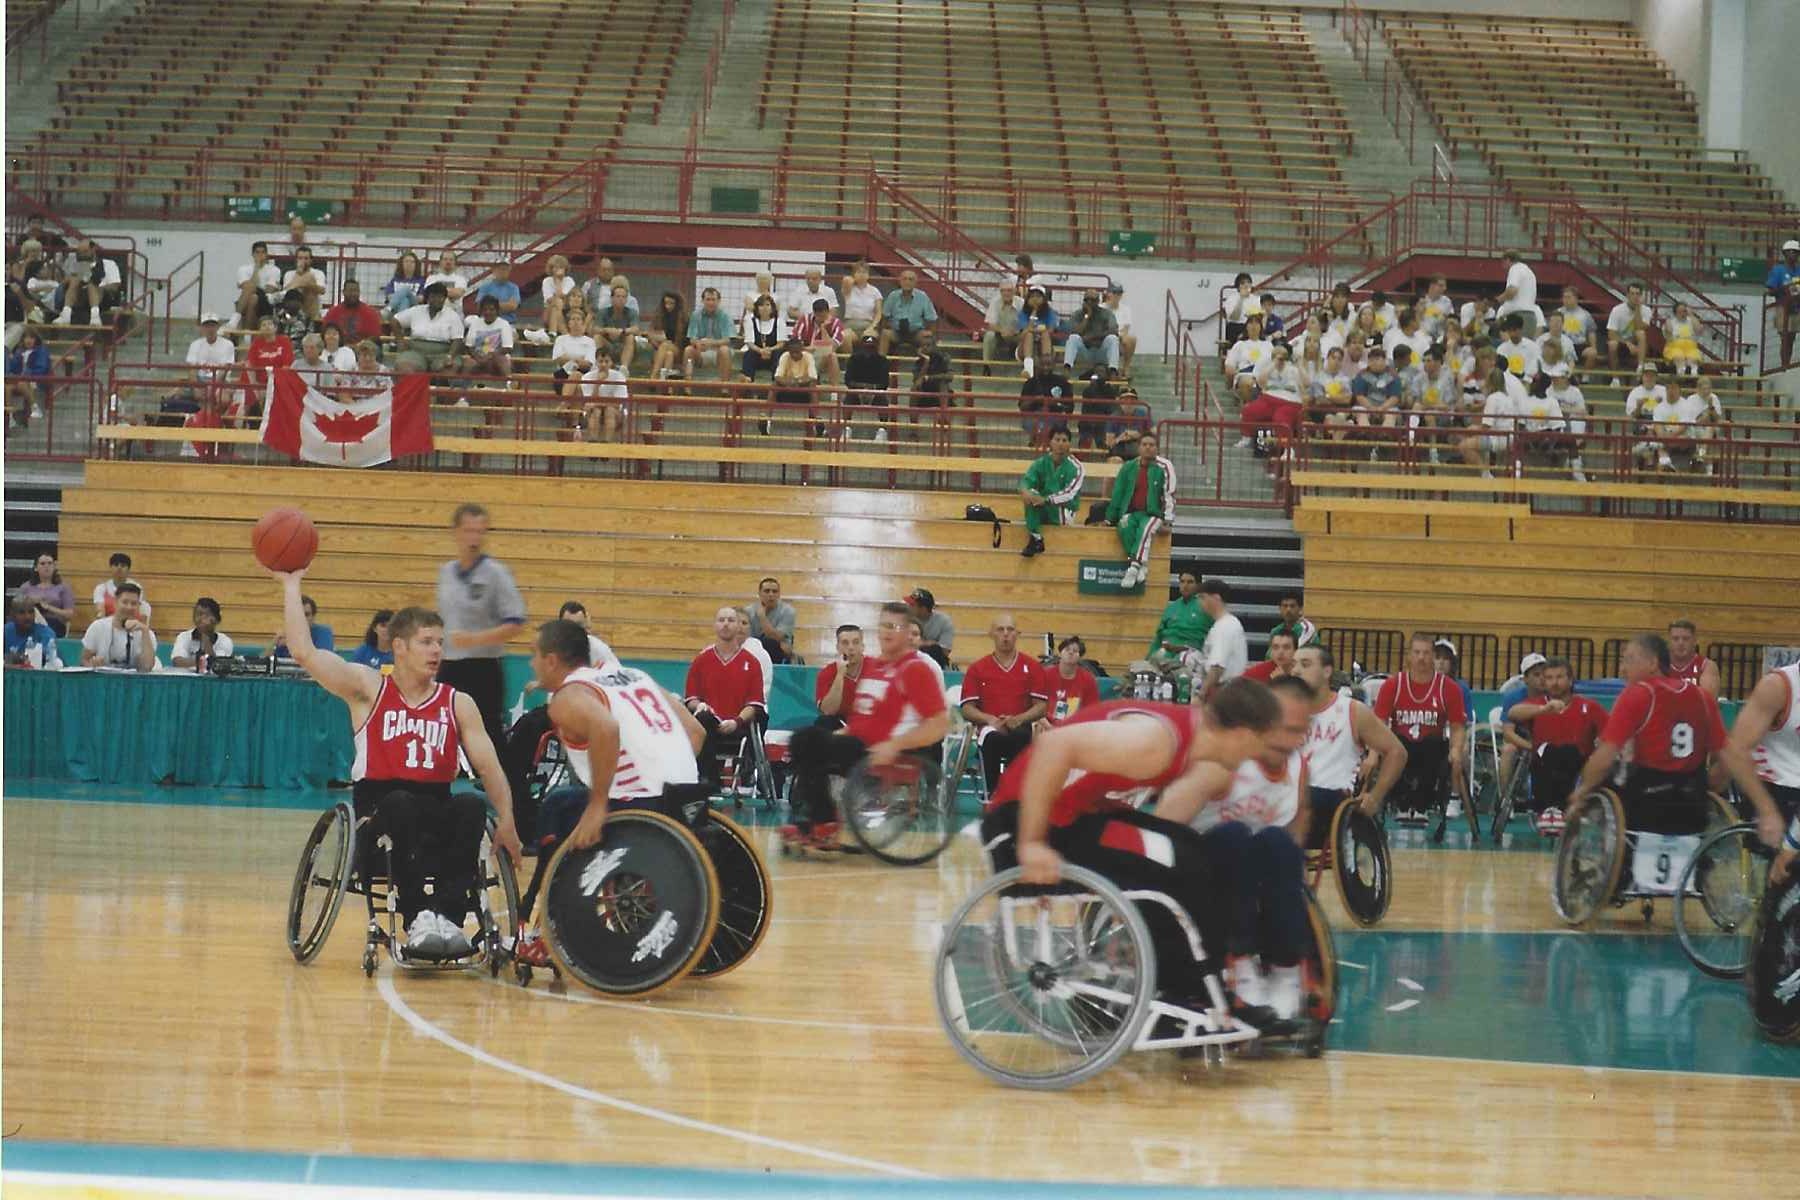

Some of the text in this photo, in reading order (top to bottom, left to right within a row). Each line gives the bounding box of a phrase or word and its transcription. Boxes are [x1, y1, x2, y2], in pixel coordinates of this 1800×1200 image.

[618, 687, 672, 733] 13
[1396, 709, 1438, 727] CANADA
[405, 738, 435, 769] 11
[1671, 722, 1695, 759] 9
[1655, 852, 1671, 884] 9
